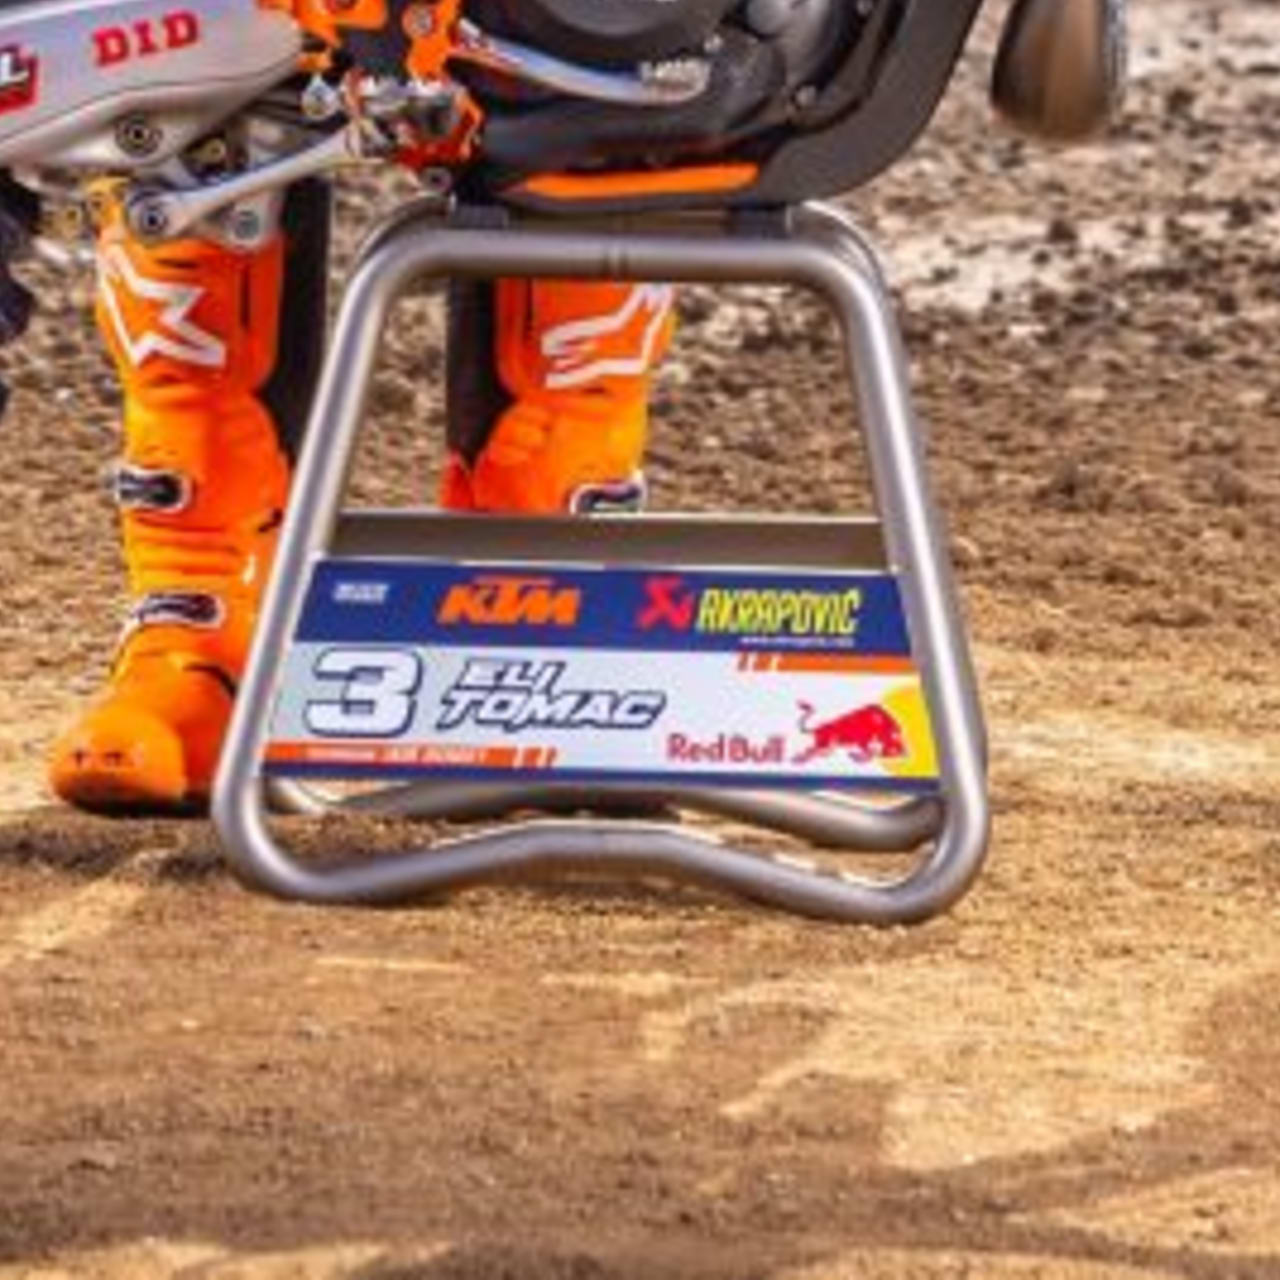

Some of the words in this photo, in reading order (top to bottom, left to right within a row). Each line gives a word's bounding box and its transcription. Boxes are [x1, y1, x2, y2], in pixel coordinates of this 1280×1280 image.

[91, 11, 199, 67] DID
[437, 573, 581, 627] KTM
[303, 647, 423, 738] 3
[454, 657, 566, 692] ELI
[435, 688, 668, 733] TOMAC
[668, 733, 725, 763] Red
[729, 737, 785, 765] Bull
